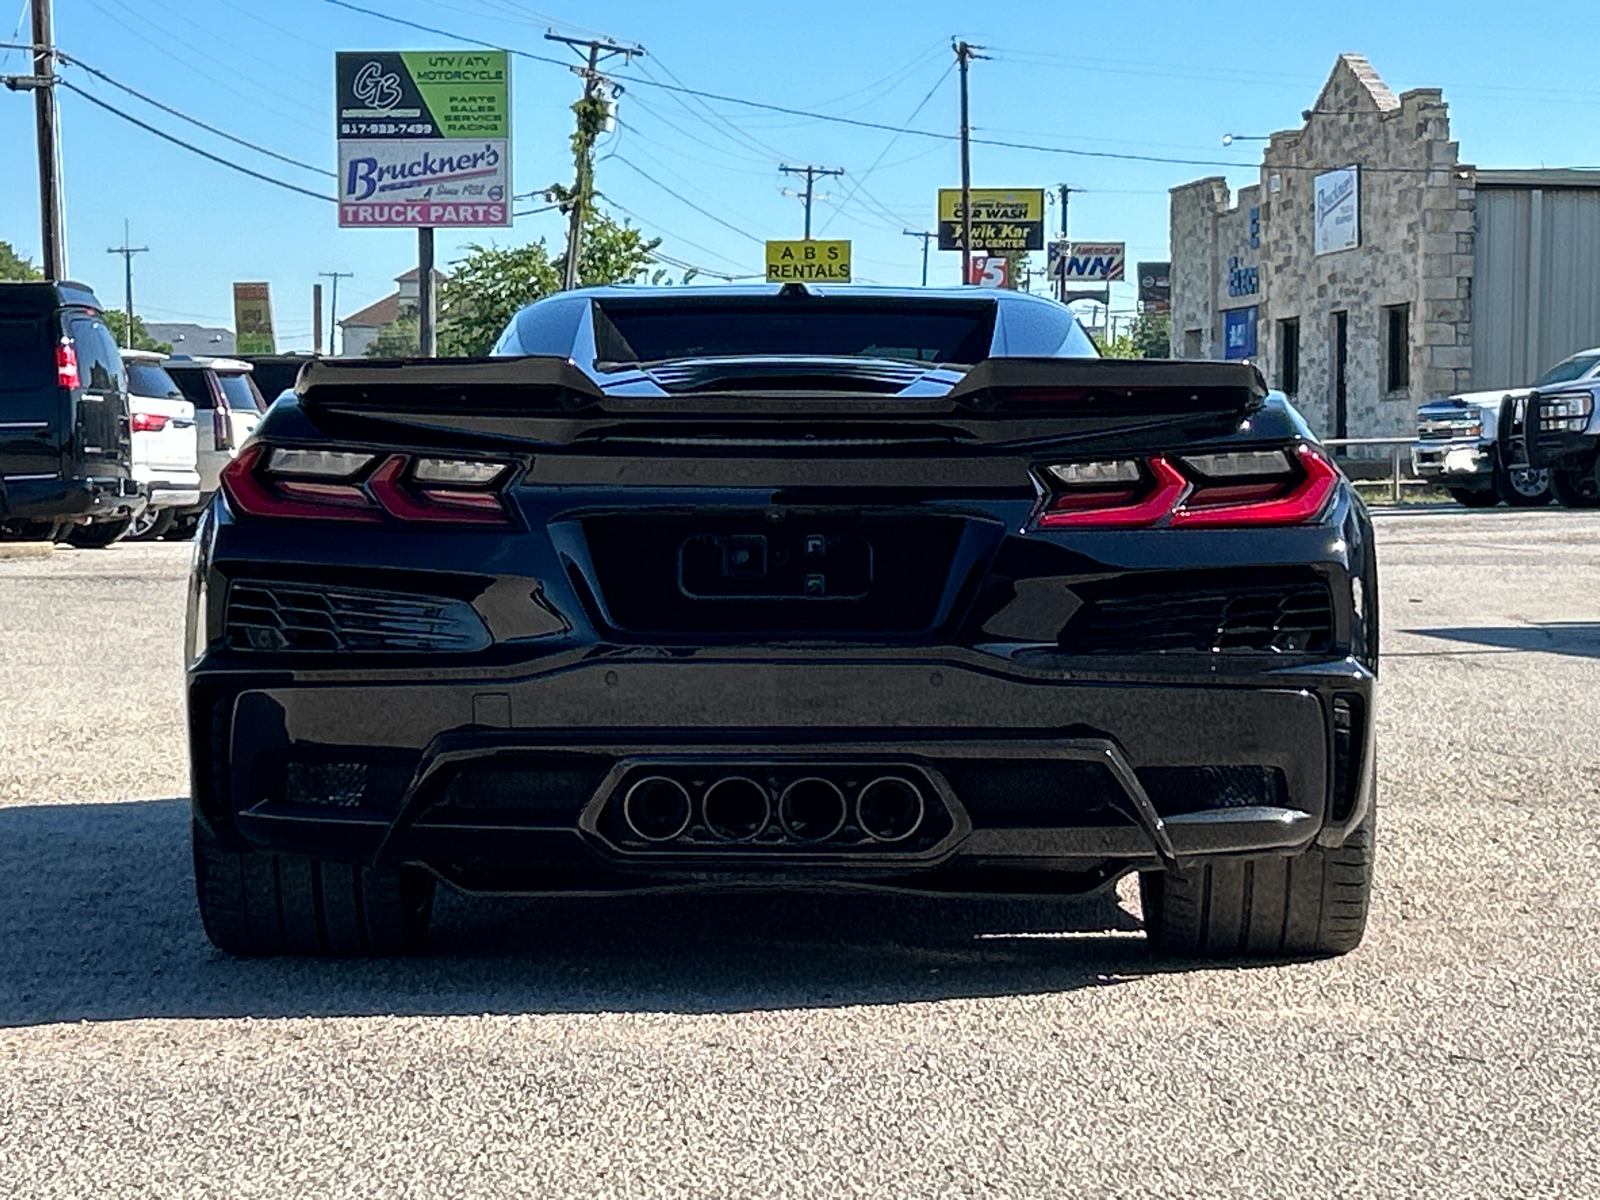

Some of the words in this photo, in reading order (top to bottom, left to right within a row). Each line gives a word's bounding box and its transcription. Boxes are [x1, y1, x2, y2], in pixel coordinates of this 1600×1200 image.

[429, 57, 456, 67] UTV
[465, 57, 491, 66] ATV
[417, 70, 503, 81] MOTORCYCLE
[346, 144, 499, 201] Bruckner's
[343, 205, 423, 222] TRUCK
[429, 205, 503, 222] PARTS
[954, 209, 982, 218] CR
[986, 209, 1029, 219] WASH
[955, 239, 983, 248] ATO
[985, 239, 1026, 248] CENTER
[768, 264, 850, 278] RENTALS
[1053, 256, 1115, 276] INN
